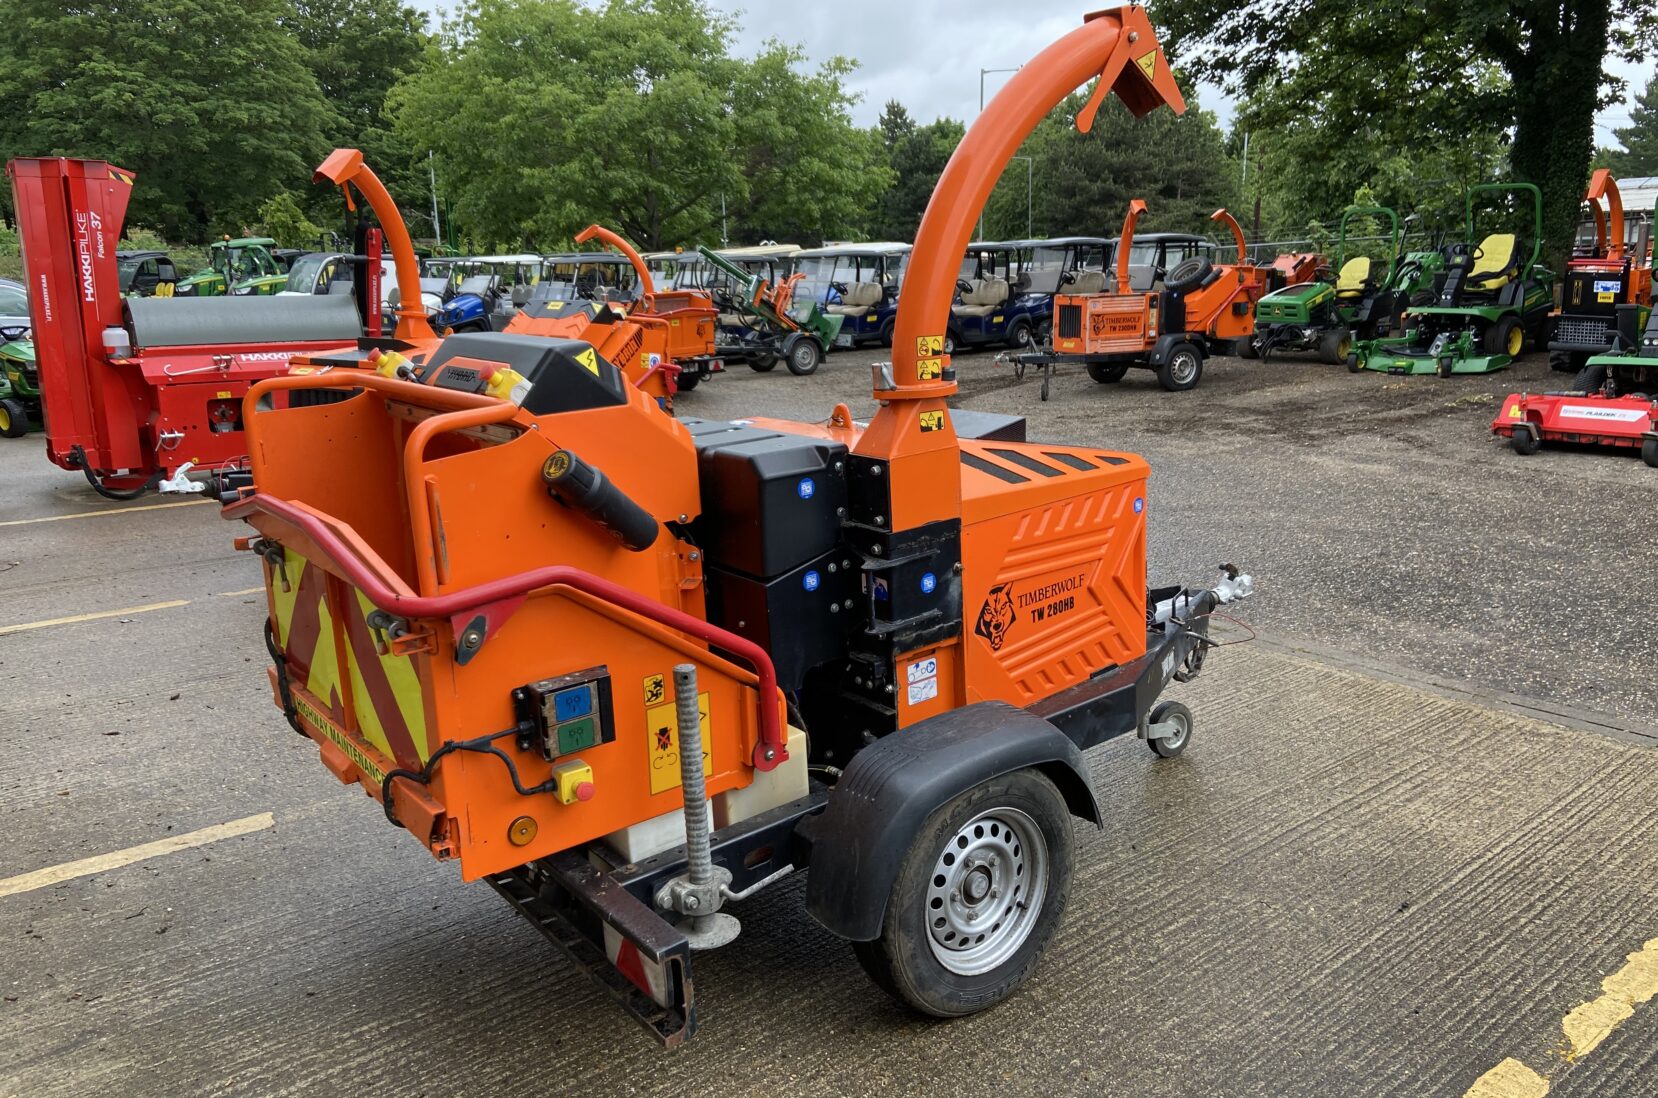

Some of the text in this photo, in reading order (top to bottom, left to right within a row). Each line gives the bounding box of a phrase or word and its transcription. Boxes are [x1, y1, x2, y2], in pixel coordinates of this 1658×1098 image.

[90, 211, 105, 259] Falcon 37
[76, 212, 95, 302] HAKKIPILKE
[1105, 316, 1141, 325] TIMBERWOLF
[1017, 573, 1085, 609] TIMBERWOLF
[1031, 596, 1075, 624] TW 280HB
[296, 696, 328, 733] HIGHWAY
